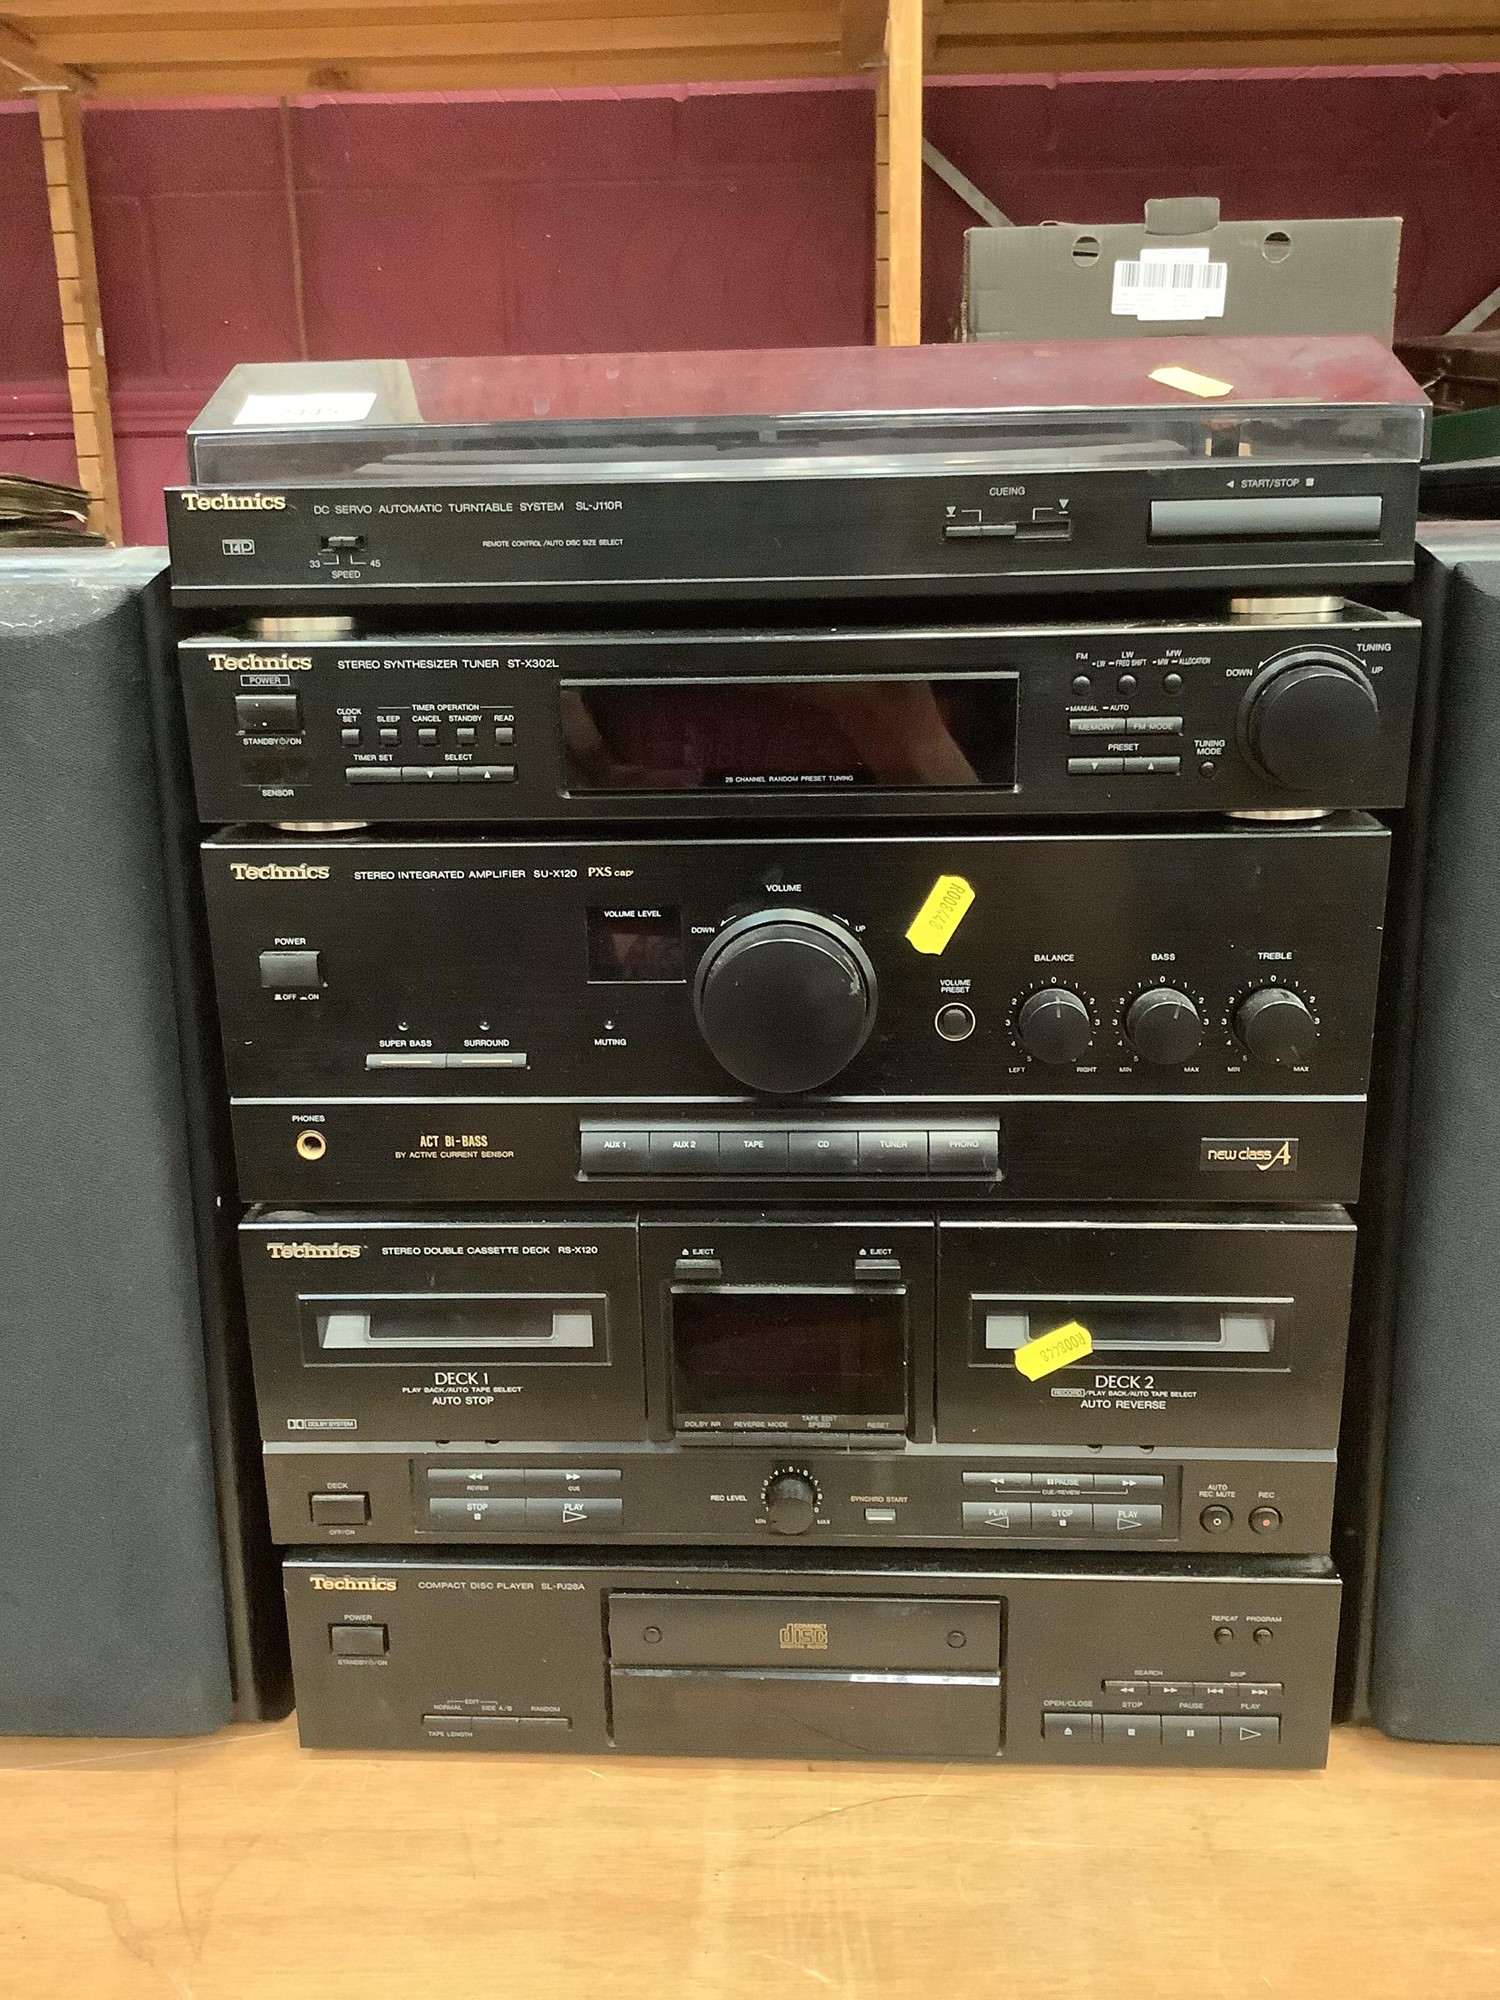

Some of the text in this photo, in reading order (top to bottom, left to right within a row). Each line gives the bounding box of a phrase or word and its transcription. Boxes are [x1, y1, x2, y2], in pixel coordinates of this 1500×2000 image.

[1241, 477, 1300, 489] START/STOP
[989, 485, 1025, 497] CUEING
[181, 492, 286, 511] Technics
[314, 501, 623, 515] DC SERVO AUTOMATIC TURNTABLE SYSTEM SL-J110R
[309, 560, 321, 568] 33
[370, 559, 381, 567] 45
[331, 571, 360, 579] SPEED
[1356, 643, 1391, 653] TUNING
[208, 653, 312, 671] Technics
[338, 658, 559, 670] STEREO SYNTHESIZER TUNER ST-X302L
[1226, 668, 1253, 678] DOWN
[1371, 666, 1383, 675] UP
[249, 676, 281, 685] POWER
[1108, 743, 1139, 751] PRESET
[262, 789, 294, 798] SENSOR
[230, 863, 330, 880] Technics
[354, 869, 577, 880] STEREO INTEGRATED AMPLIFIER SU-X120
[588, 867, 612, 877] PXS
[855, 925, 866, 933] UP
[1034, 954, 1075, 962] BALANCE
[1151, 953, 1176, 961] BASS
[1258, 952, 1292, 960] TREBLE
[379, 1040, 432, 1048] SUPER BASS
[464, 1039, 510, 1047] SURROUND
[594, 1038, 627, 1046] MUTING
[292, 1115, 325, 1123] PHONES
[420, 1135, 488, 1147] ACT Bi-BASS
[818, 1140, 829, 1148] CD
[880, 1140, 907, 1148] TUNER
[949, 1140, 979, 1148] PHONO
[1208, 1141, 1291, 1171] new class A
[267, 1242, 361, 1259] Technics
[382, 1246, 598, 1255] STEREO DOUBLE CASSETTE DECK RS-X120
[434, 1372, 489, 1385] DECK 1
[1095, 1375, 1154, 1389] DECK 2
[432, 1396, 494, 1405] AUTO STOP
[1081, 1400, 1166, 1409] AUTO REVERSE
[310, 1576, 397, 1591] Technics
[470, 1582, 493, 1590] DISC
[497, 1582, 534, 1590] PLAYER
[1179, 1702, 1204, 1710] PAUSE
